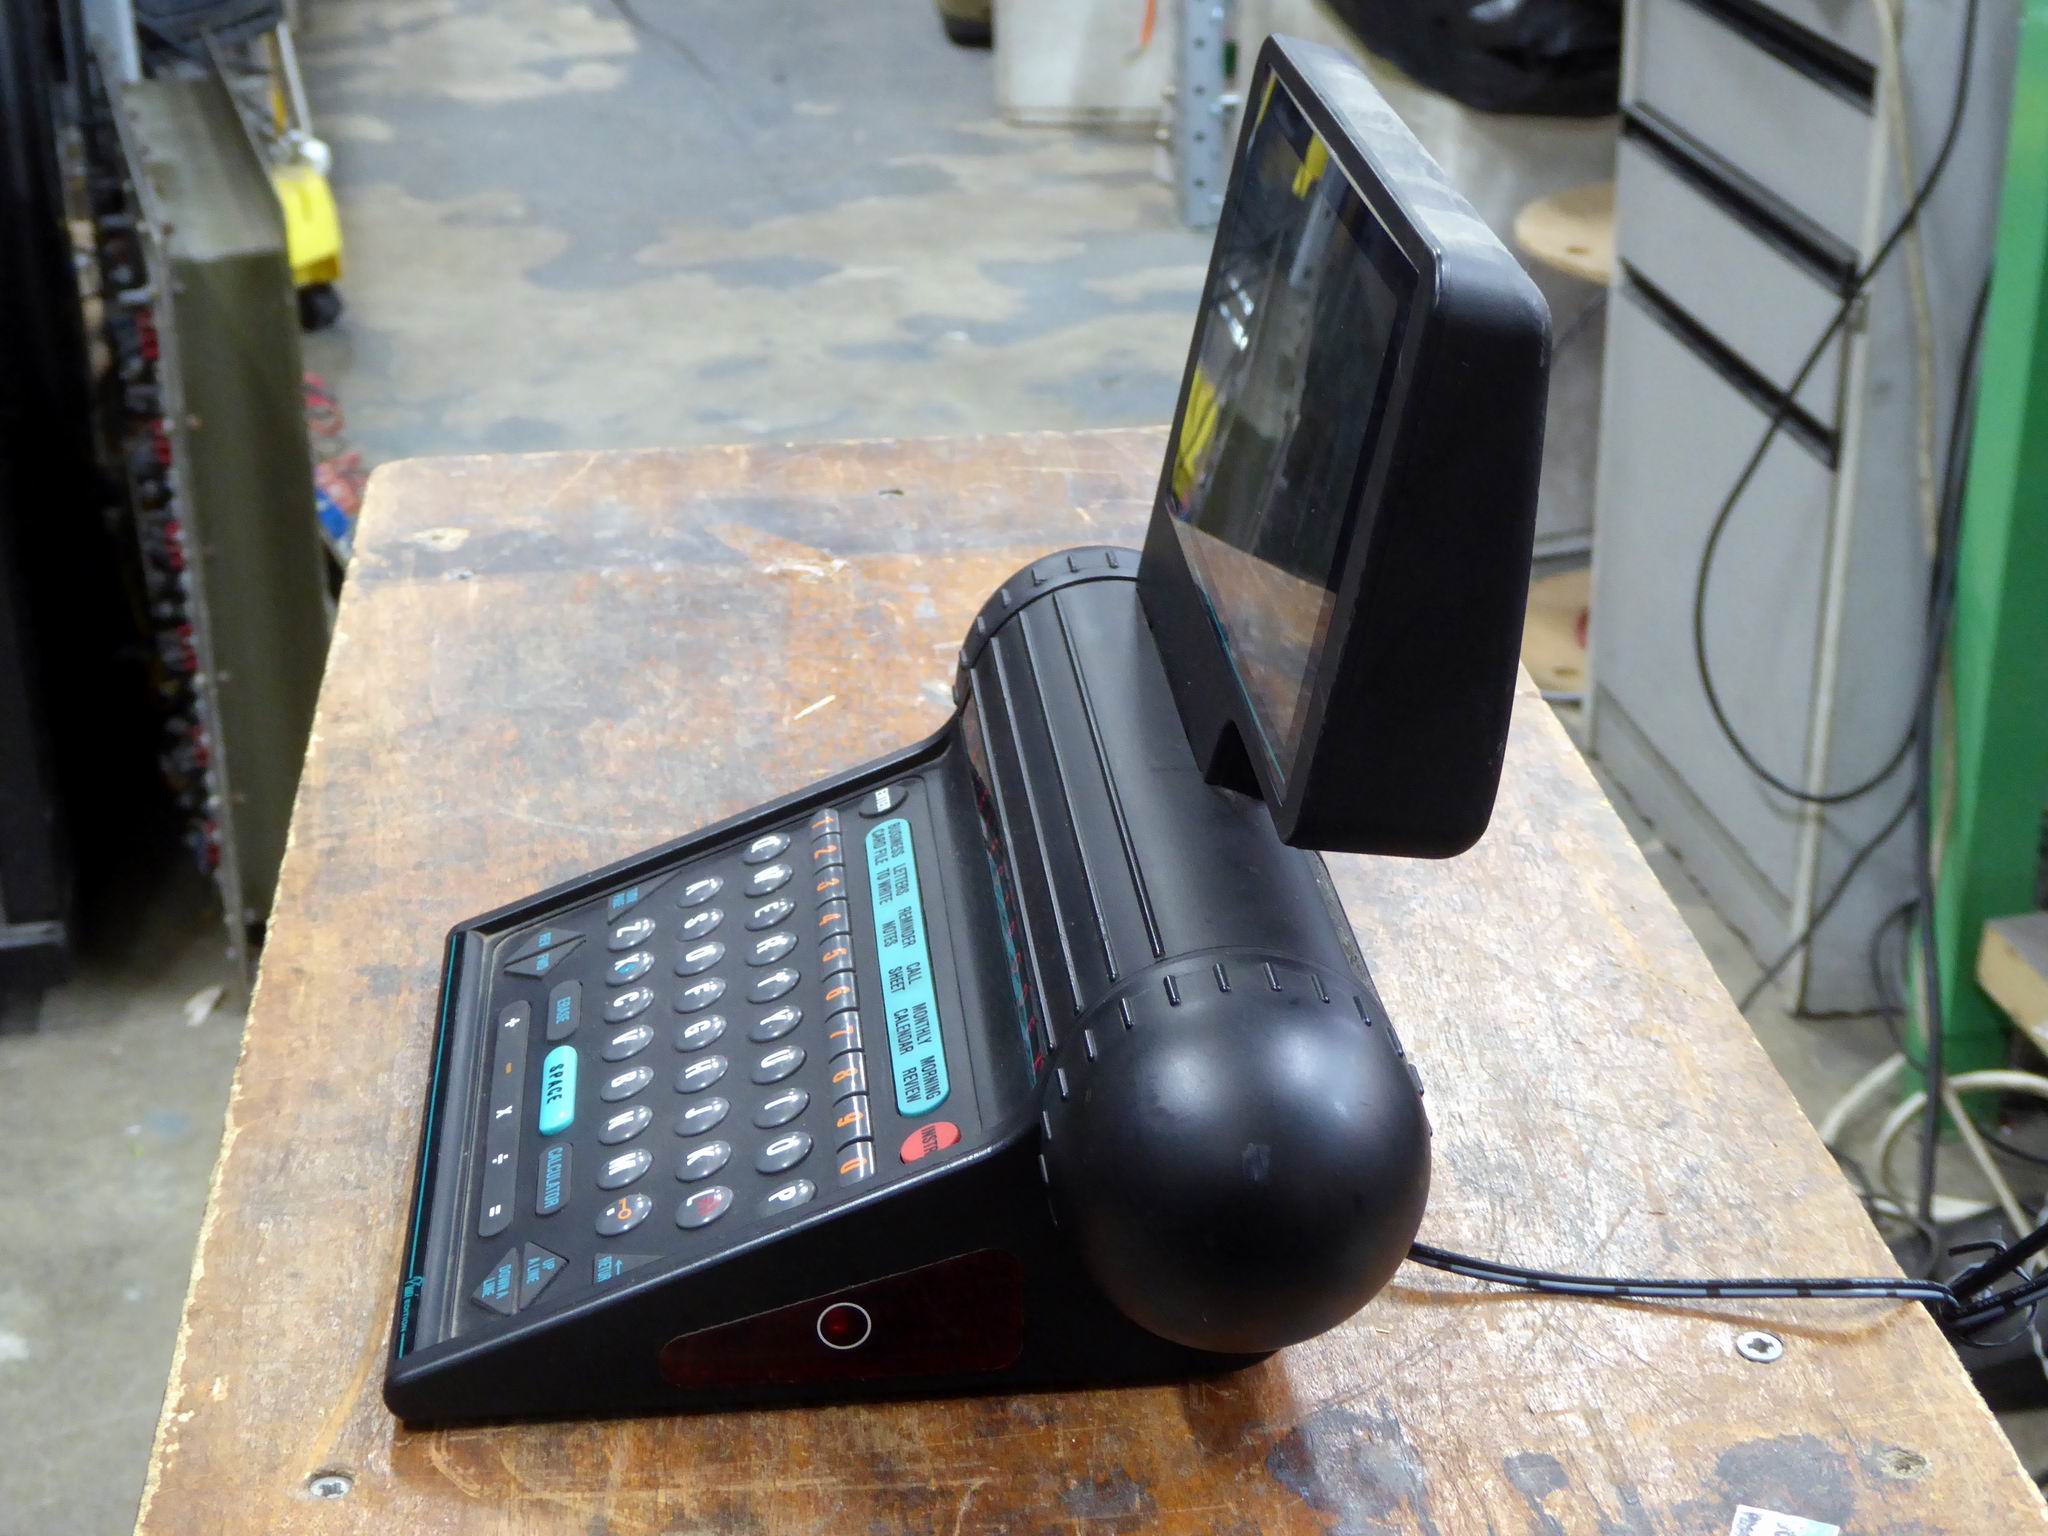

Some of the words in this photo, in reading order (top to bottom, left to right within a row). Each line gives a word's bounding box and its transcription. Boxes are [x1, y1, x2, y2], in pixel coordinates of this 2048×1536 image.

[888, 822, 905, 858] BUSINESS
[814, 845, 837, 859] 2
[874, 848, 888, 866] FILE
[754, 865, 784, 884] W
[877, 868, 890, 880] TO
[893, 863, 910, 896] LETTERS
[686, 879, 710, 896] A
[816, 878, 840, 891] 3
[878, 879, 893, 906] WRITE
[754, 901, 779, 918] E
[616, 921, 641, 938] Z
[684, 912, 709, 929] S
[898, 905, 917, 949] REMINDER
[882, 920, 899, 948] NOTES
[685, 945, 715, 962] D
[756, 935, 786, 954] R
[614, 953, 640, 971] X
[823, 948, 848, 962] 5
[757, 971, 785, 988] T
[888, 966, 906, 993] SHEET
[906, 961, 923, 985] CALL
[613, 991, 640, 1007] C
[684, 983, 710, 997] F
[826, 986, 850, 1000] 6
[556, 996, 571, 1024] ERASE
[760, 1009, 792, 1026] Y
[684, 1020, 711, 1038] G
[830, 1025, 854, 1039] 7
[893, 1008, 914, 1056] CALENDAR
[912, 1002, 932, 1046] MONTHLY
[612, 1029, 639, 1045] V
[761, 1049, 793, 1068] U
[685, 1059, 712, 1079] H
[832, 1068, 858, 1083] 8
[920, 1055, 941, 1101] MORNING
[546, 1063, 565, 1105] SPACE
[610, 1070, 637, 1088] B
[902, 1066, 922, 1104] REVIEW
[608, 1110, 634, 1131] N
[685, 1105, 713, 1119] J
[837, 1111, 864, 1127] 9
[766, 1136, 799, 1156] O
[608, 1152, 636, 1176] M
[687, 1145, 715, 1166] K
[840, 1157, 867, 1174] 0
[543, 1146, 563, 1209] CALCULATOR
[686, 1188, 715, 1207] L
[768, 1186, 796, 1202] P
[542, 1257, 556, 1270] UP
[497, 1264, 512, 1288] DOWN
